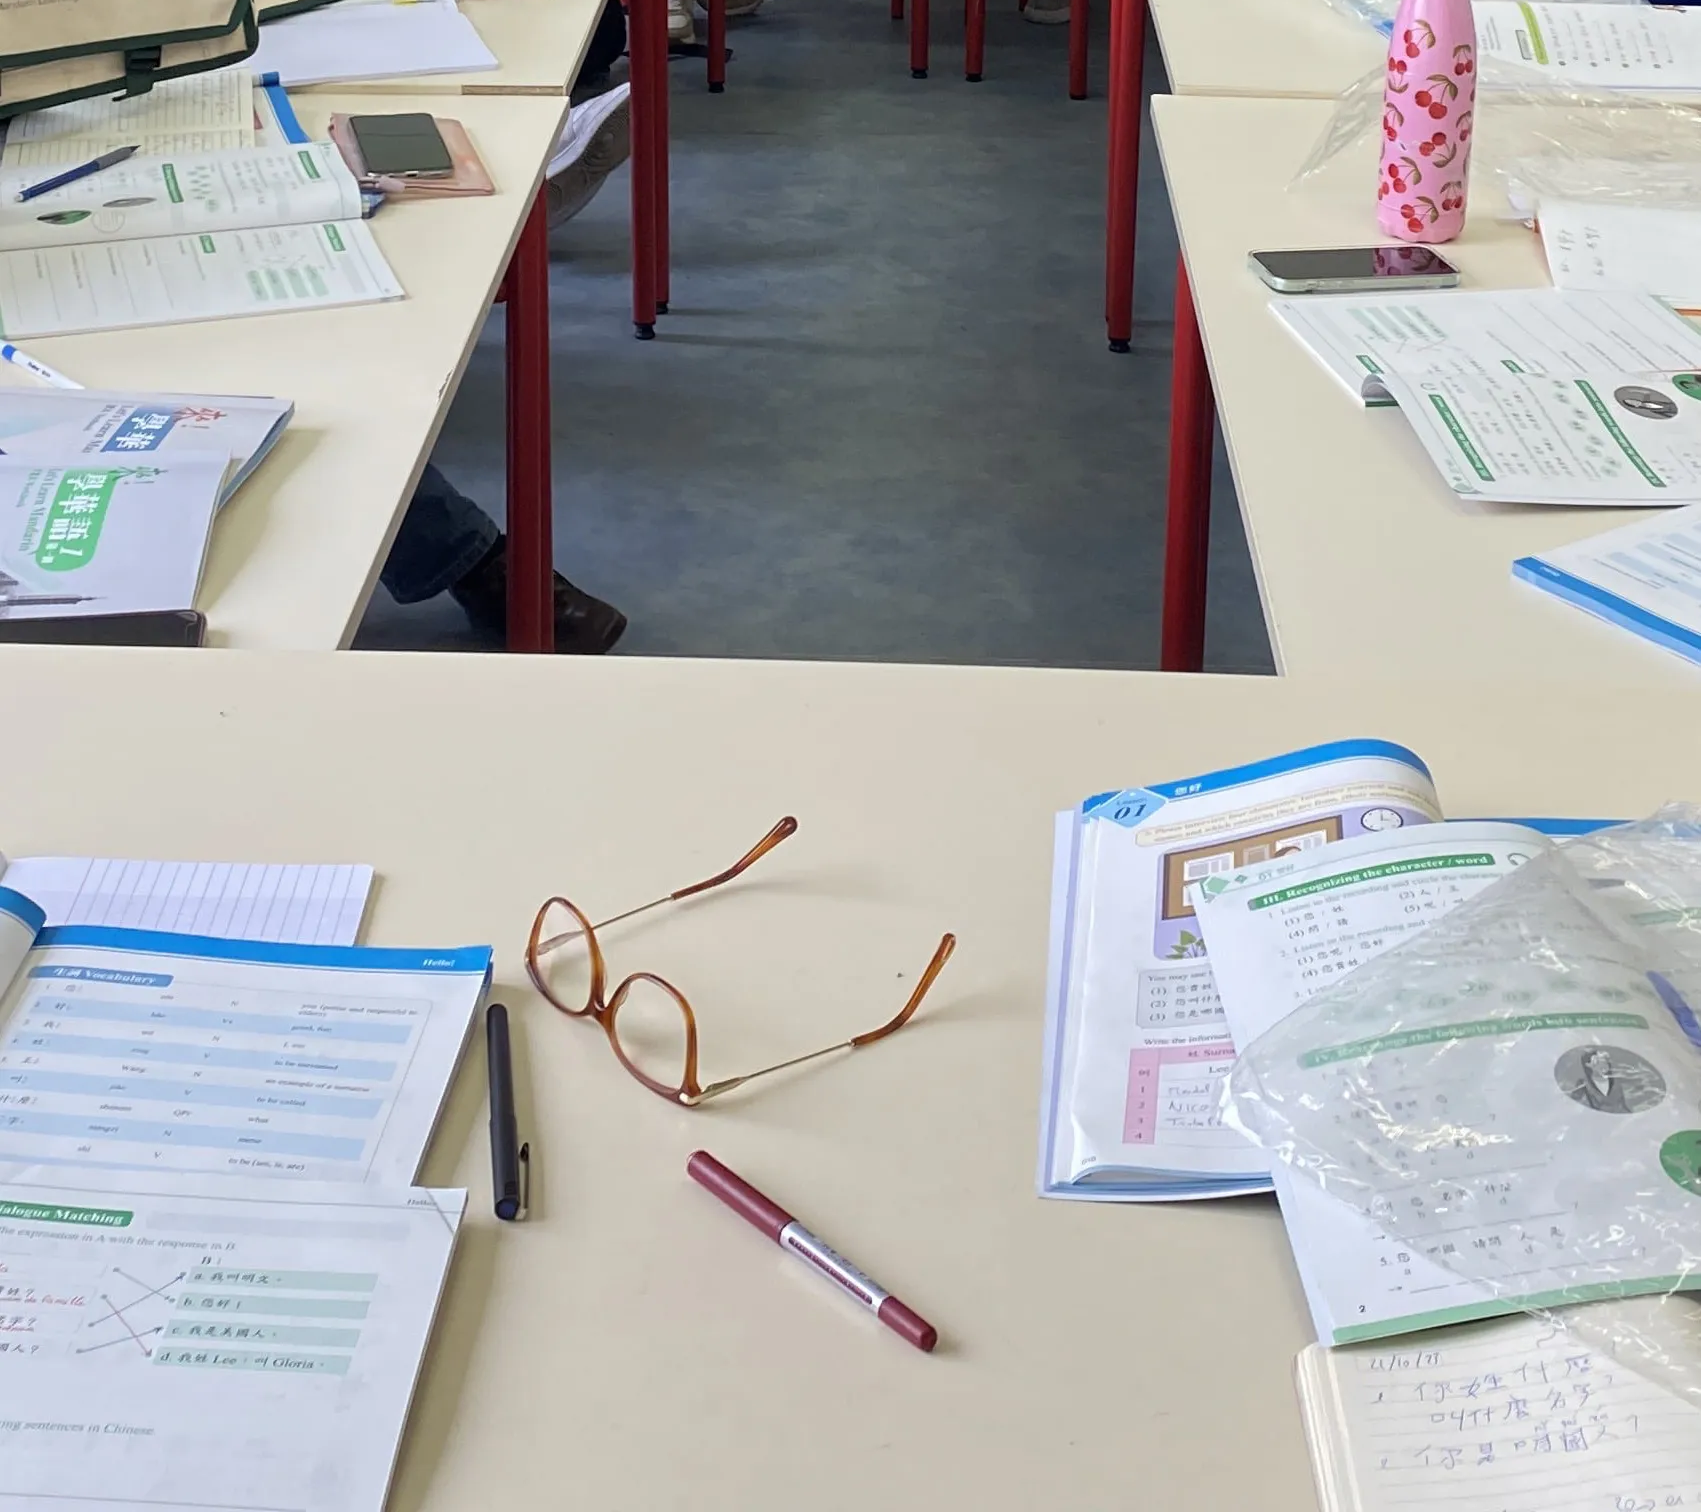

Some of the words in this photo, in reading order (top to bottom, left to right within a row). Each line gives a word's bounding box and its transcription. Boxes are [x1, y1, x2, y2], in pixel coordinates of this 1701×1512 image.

[1113, 804, 1147, 821] 01
[1285, 873, 1362, 899] Recognizing
[1362, 867, 1383, 881] the
[1385, 859, 1444, 875] character
[1455, 855, 1490, 866] word
[85, 970, 157, 984] Vocabulary
[0, 1205, 51, 1220] ialogue
[52, 1208, 125, 1226] Matching
[17, 1228, 80, 1241] expression
[108, 1235, 135, 1245] with
[157, 1238, 208, 1250] response
[1358, 1303, 1367, 1314] 2
[0, 1419, 21, 1432] ing
[23, 1420, 85, 1433] sentences
[86, 1422, 102, 1434] in
